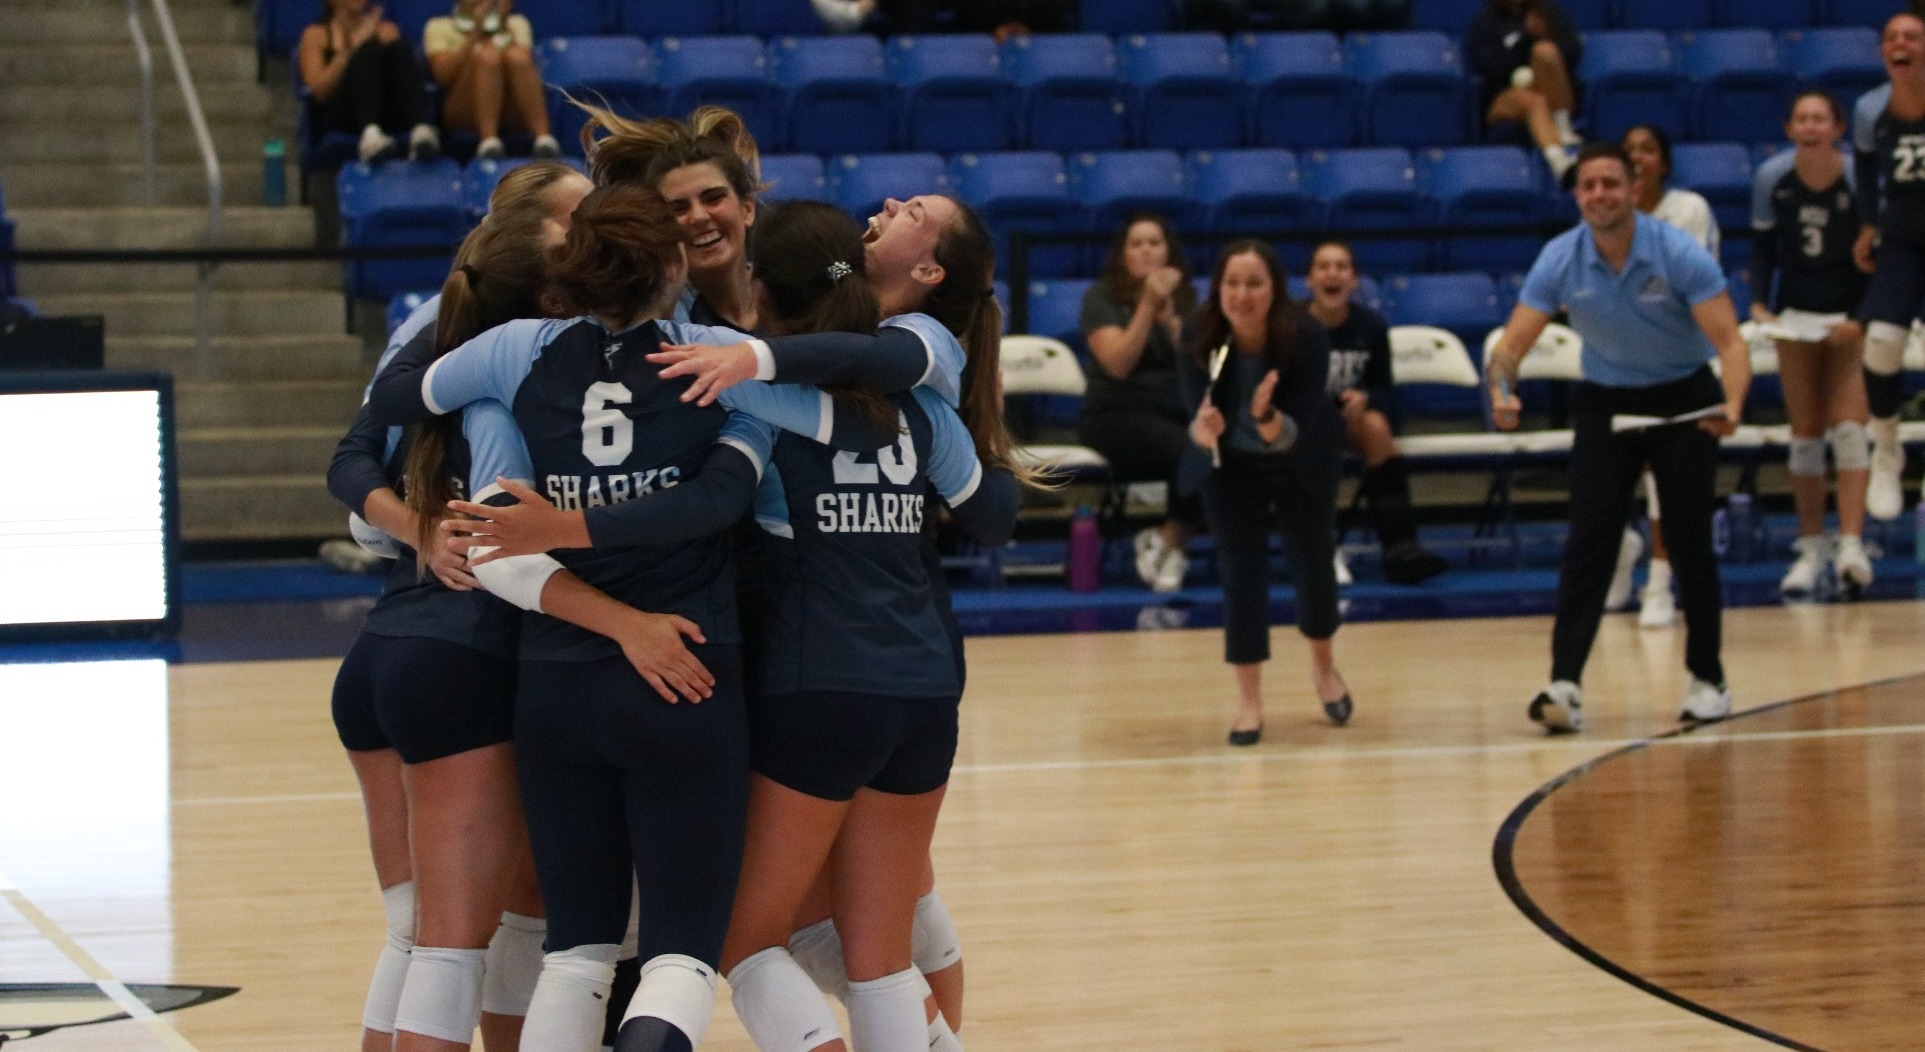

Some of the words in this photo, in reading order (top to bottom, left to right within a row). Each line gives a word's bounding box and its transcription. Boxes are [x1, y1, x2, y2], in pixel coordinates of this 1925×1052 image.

[1802, 227, 1823, 255] 3
[581, 381, 633, 466] 6
[816, 492, 924, 533] SHARKS
